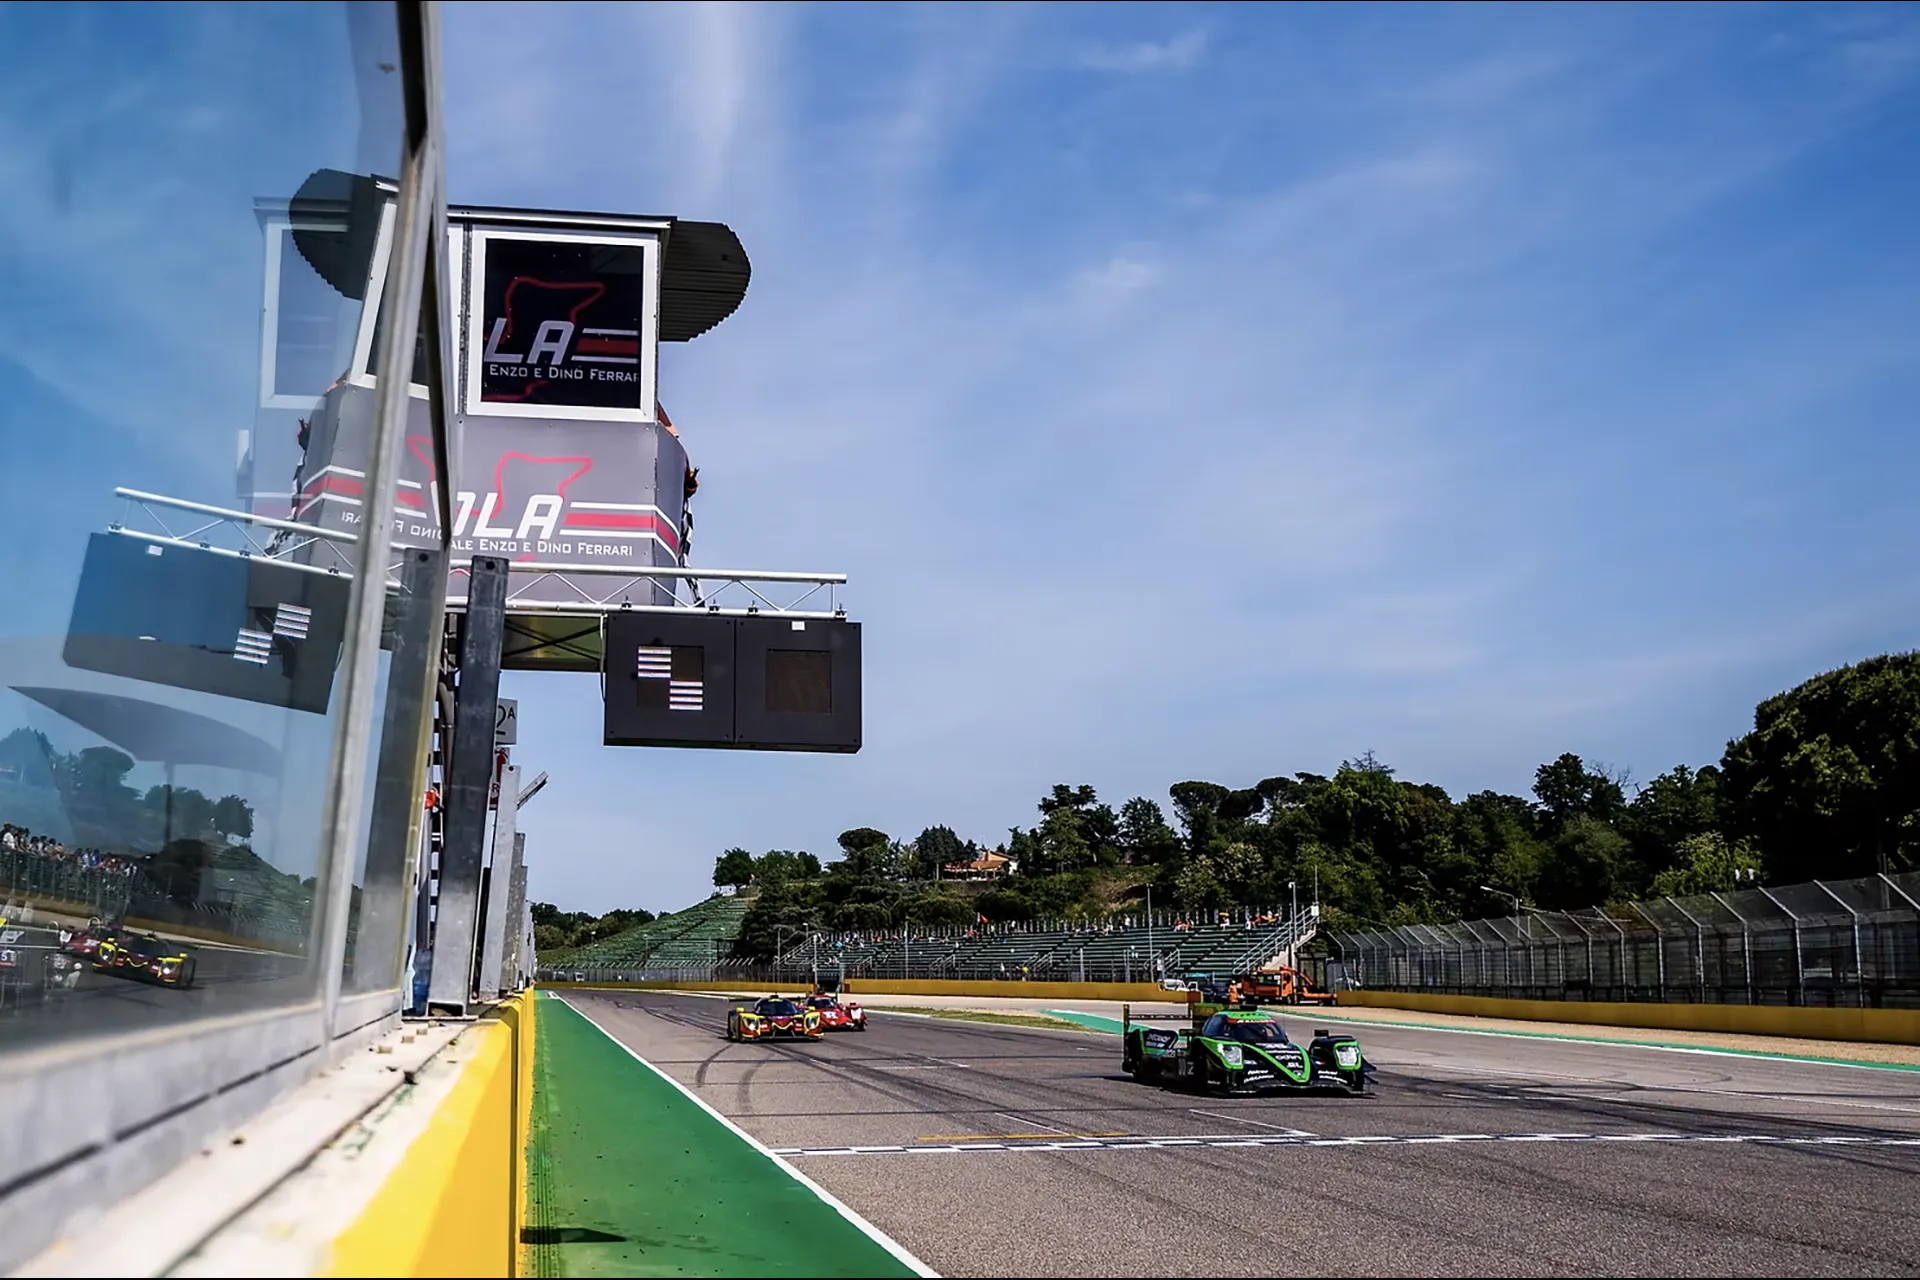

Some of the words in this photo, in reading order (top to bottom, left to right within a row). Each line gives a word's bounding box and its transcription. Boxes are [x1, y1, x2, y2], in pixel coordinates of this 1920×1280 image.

[489, 364, 528, 378] ENZO
[534, 367, 542, 378] E
[549, 366, 584, 380] DINO
[479, 539, 517, 552] ENZO
[523, 543, 531, 552] E
[537, 542, 571, 554] DINO
[578, 542, 633, 556] FERRARI
